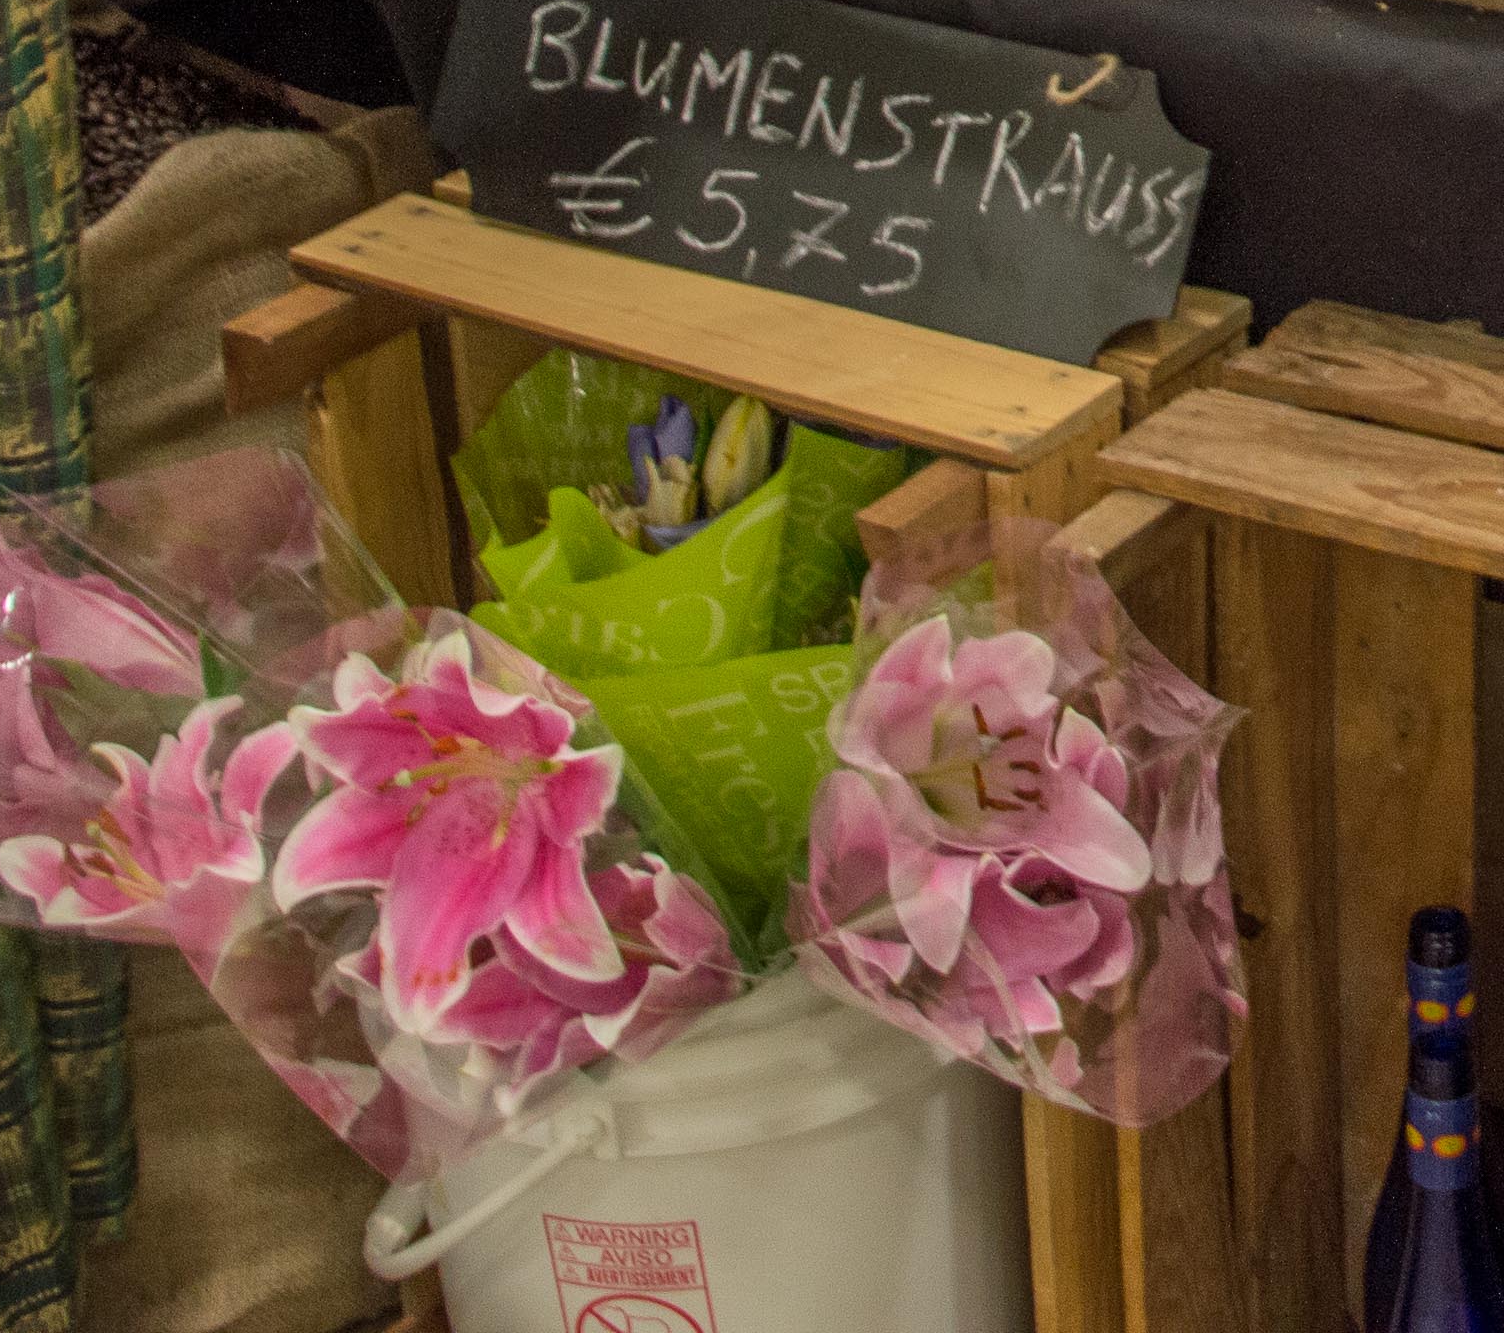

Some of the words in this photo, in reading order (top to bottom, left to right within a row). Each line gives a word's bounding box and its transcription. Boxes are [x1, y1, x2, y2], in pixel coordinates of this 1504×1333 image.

[575, 1226, 690, 1247] WARNING
[600, 1248, 673, 1267] AVISO
[586, 1265, 697, 1286] AVERTISSEMENT
